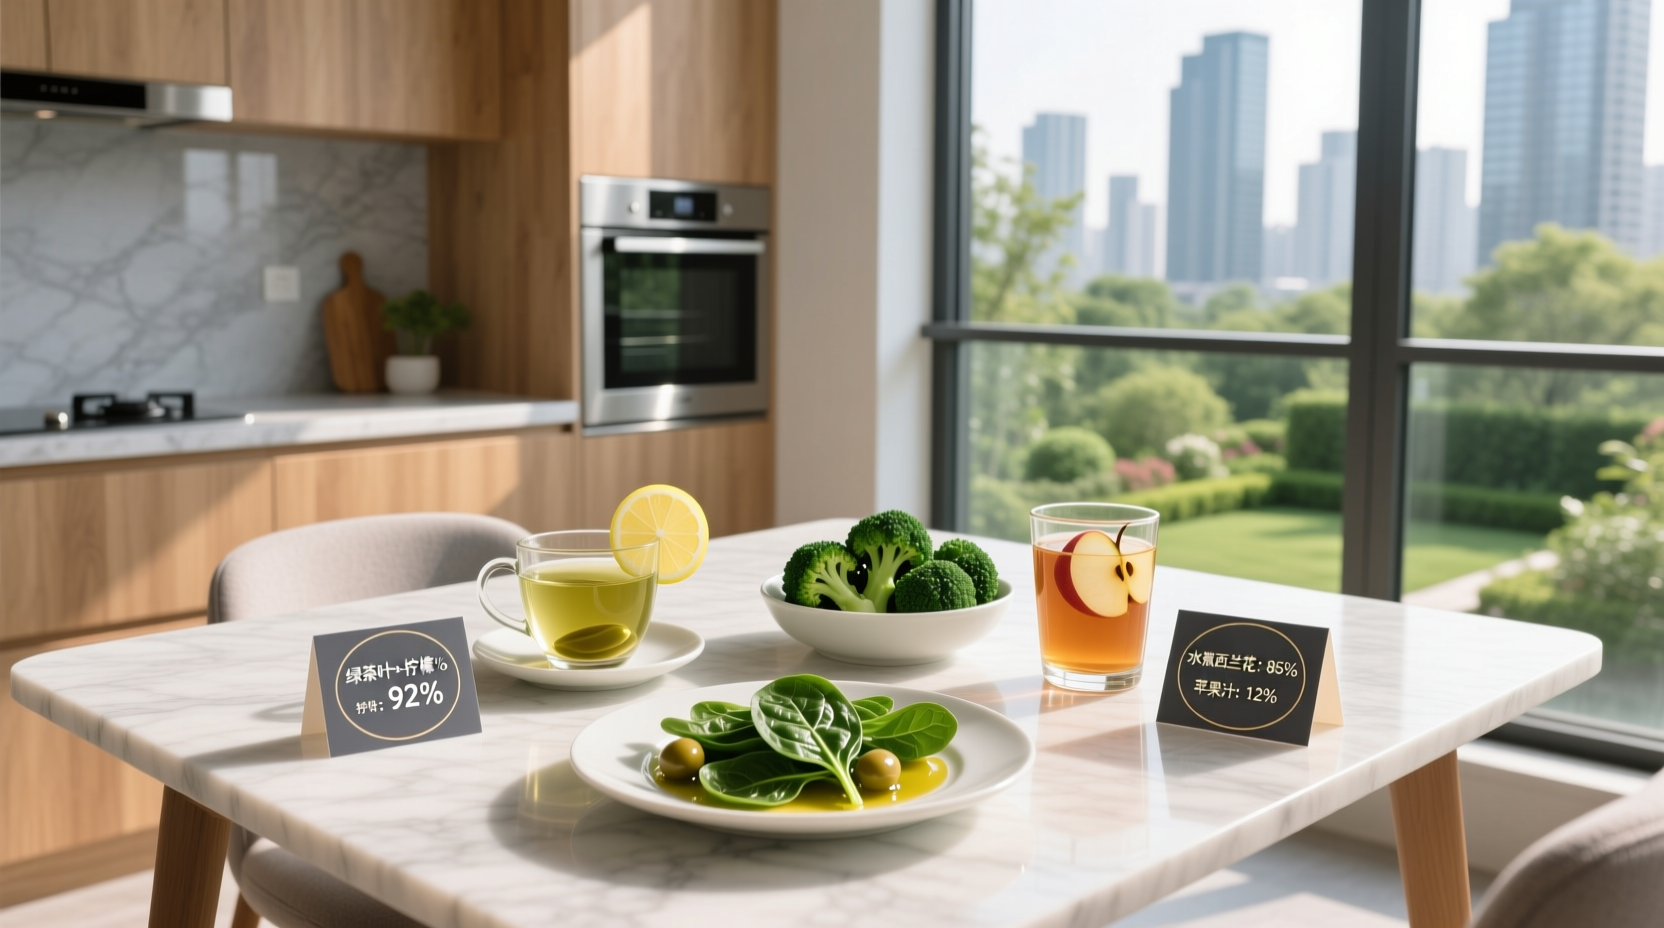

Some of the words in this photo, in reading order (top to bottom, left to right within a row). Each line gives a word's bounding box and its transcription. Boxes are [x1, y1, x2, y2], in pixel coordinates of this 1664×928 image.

[1266, 660, 1298, 677] 85%
[388, 680, 444, 710] 92%
[1246, 686, 1278, 704] 12%
